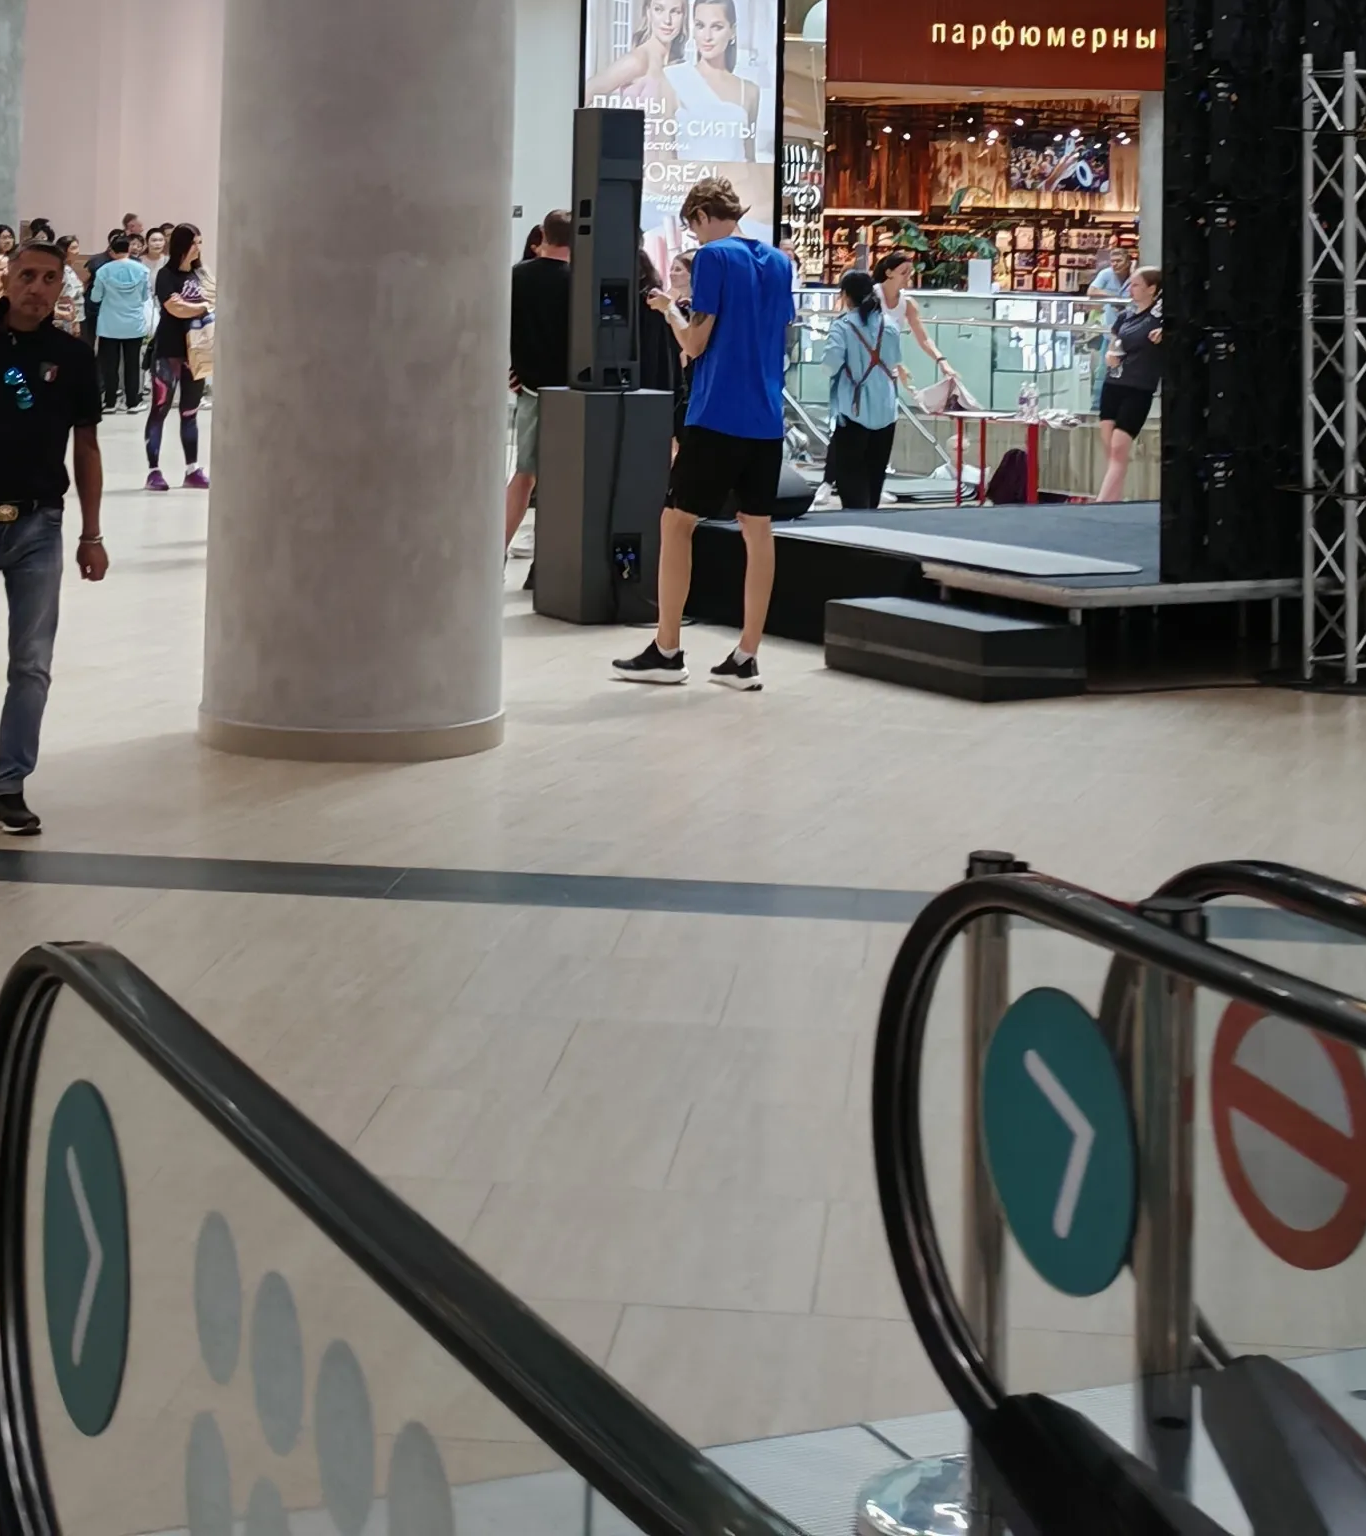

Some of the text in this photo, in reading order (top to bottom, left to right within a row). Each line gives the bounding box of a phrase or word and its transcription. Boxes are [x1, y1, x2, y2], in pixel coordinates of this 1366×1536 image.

[931, 19, 1158, 54] парфюмерны
[644, 118, 757, 139] ЕТО: СИЯТЬ!
